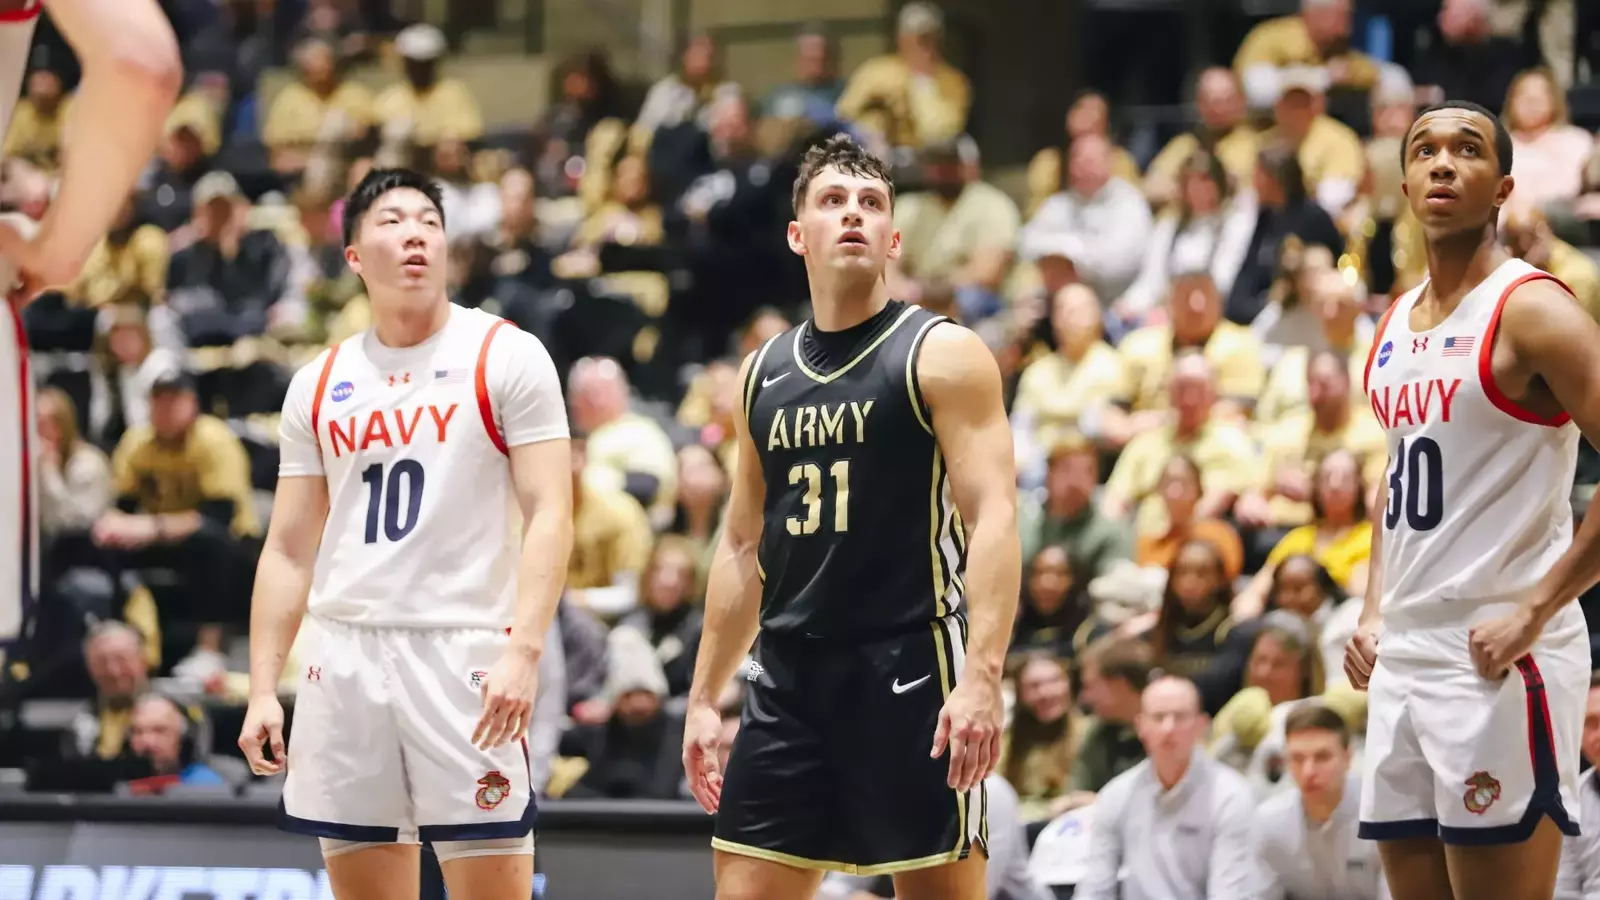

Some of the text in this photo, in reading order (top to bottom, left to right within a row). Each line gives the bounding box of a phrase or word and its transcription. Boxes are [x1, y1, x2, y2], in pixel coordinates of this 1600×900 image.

[328, 403, 458, 457] NAVY
[767, 398, 876, 451] ARMY
[1371, 379, 1462, 430] NAVY
[362, 459, 425, 544] 10
[785, 458, 851, 536] 31
[1385, 436, 1443, 531] 30
